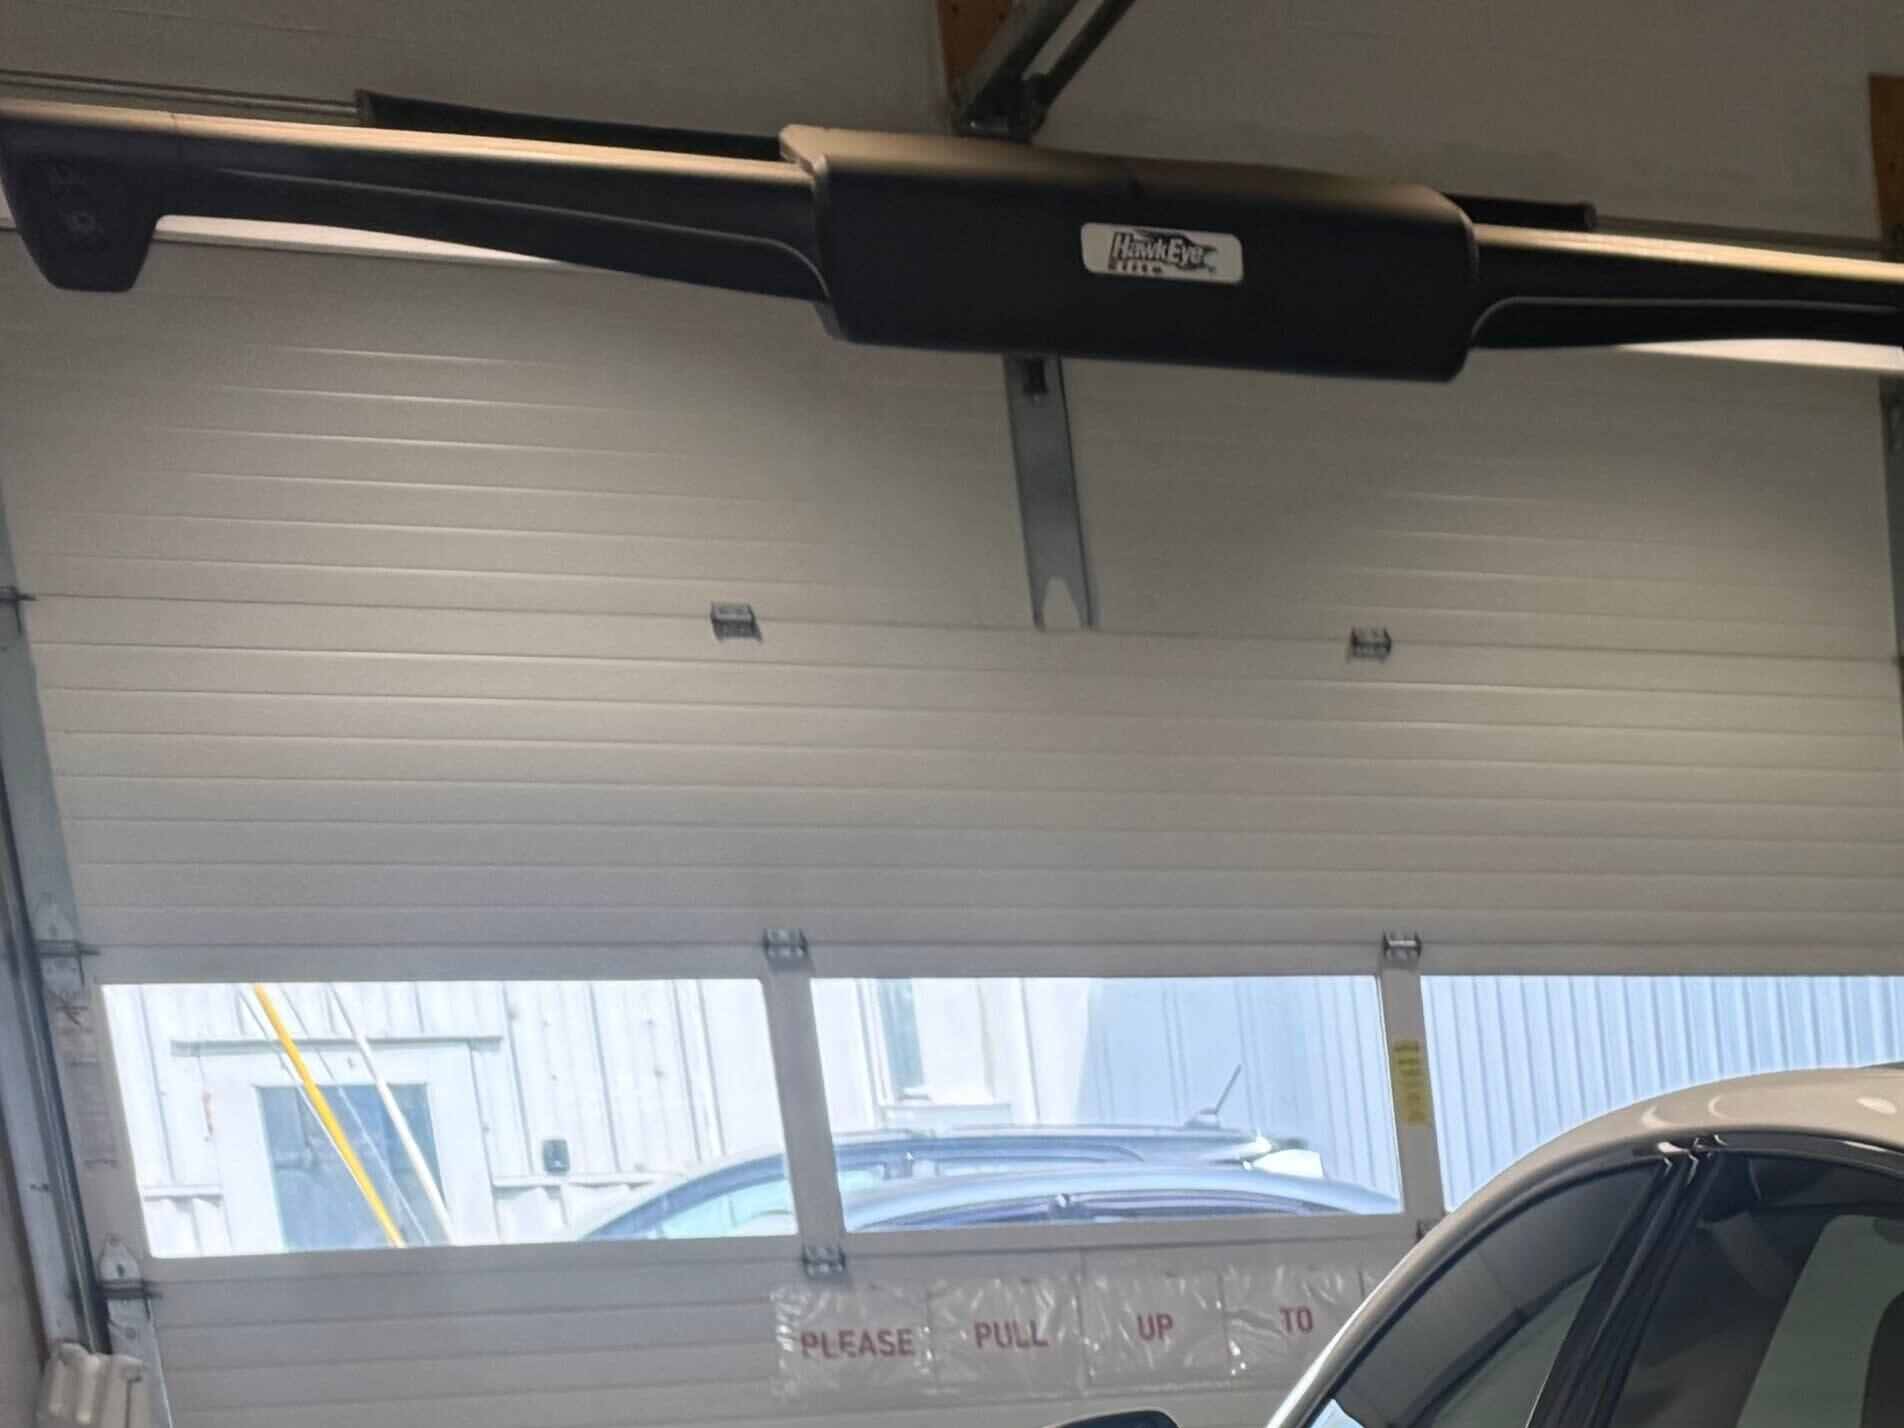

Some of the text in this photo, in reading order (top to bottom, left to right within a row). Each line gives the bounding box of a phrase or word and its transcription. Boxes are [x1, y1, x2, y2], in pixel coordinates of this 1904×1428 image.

[1110, 231, 1205, 268] HawkEye
[800, 1307, 1314, 1359] PLEASE PULL UP TO
